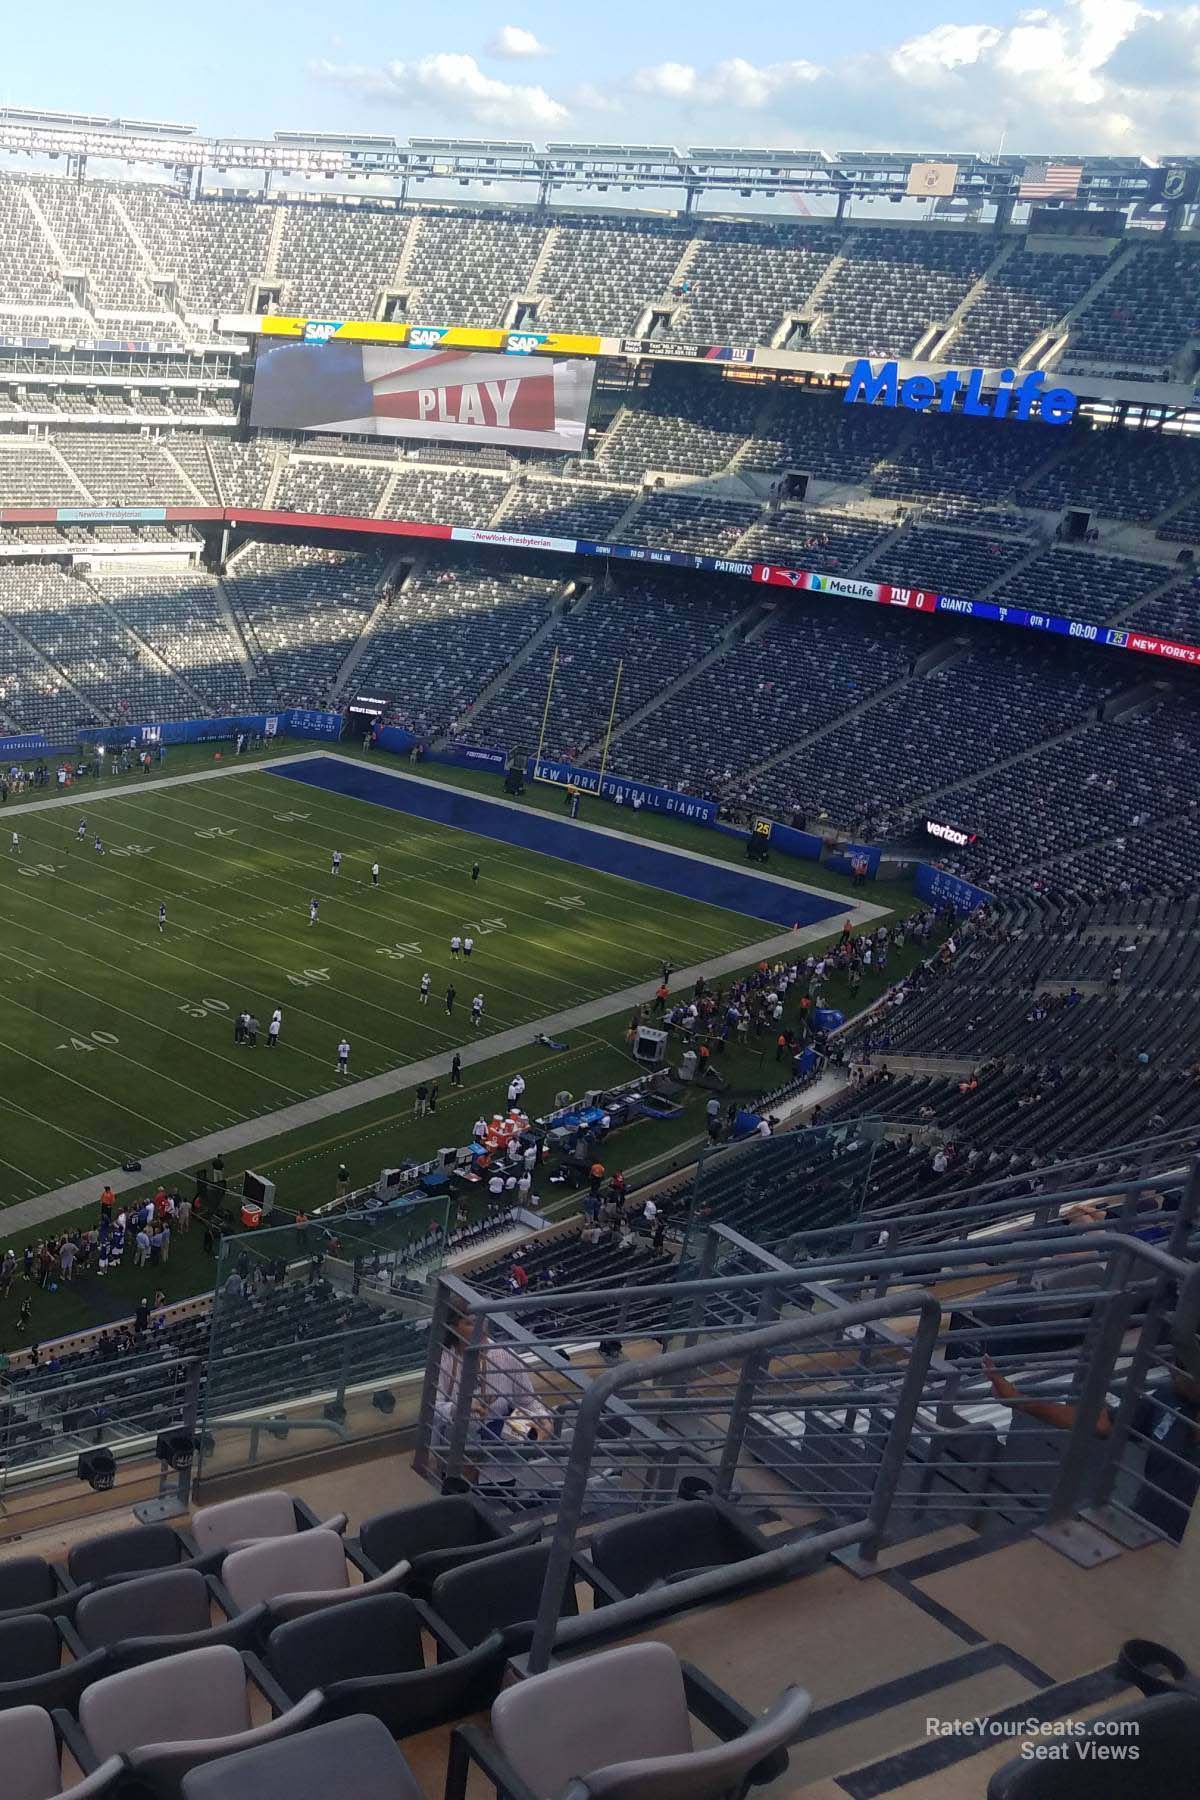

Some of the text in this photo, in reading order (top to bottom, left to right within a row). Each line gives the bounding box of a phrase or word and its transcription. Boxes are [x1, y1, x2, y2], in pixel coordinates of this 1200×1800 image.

[306, 324, 336, 340] SAP
[410, 330, 442, 346] SAP
[507, 336, 539, 352] SAP
[844, 358, 1078, 425] MetLife
[418, 378, 521, 427] PLAY
[475, 532, 551, 548] NewYork-Presbyterian
[714, 560, 770, 581] PATRIOTS 0
[830, 580, 874, 597] MetLife
[890, 588, 910, 605] ny
[916, 592, 973, 613] 0 GIANTS
[1030, 615, 1050, 628] QTR 1
[1069, 622, 1097, 640] 60:00
[1113, 633, 1123, 644] 25
[1132, 638, 1158, 650] NEW
[1160, 643, 1195, 660] YORK'S
[534, 766, 708, 820] NEW YORK FOOTBALL GIANTS
[758, 822, 770, 835] 25
[463, 918, 507, 934] 20
[375, 942, 422, 960] 30
[285, 968, 330, 987] 40
[178, 998, 230, 1018] 50
[70, 1030, 120, 1052] 40
